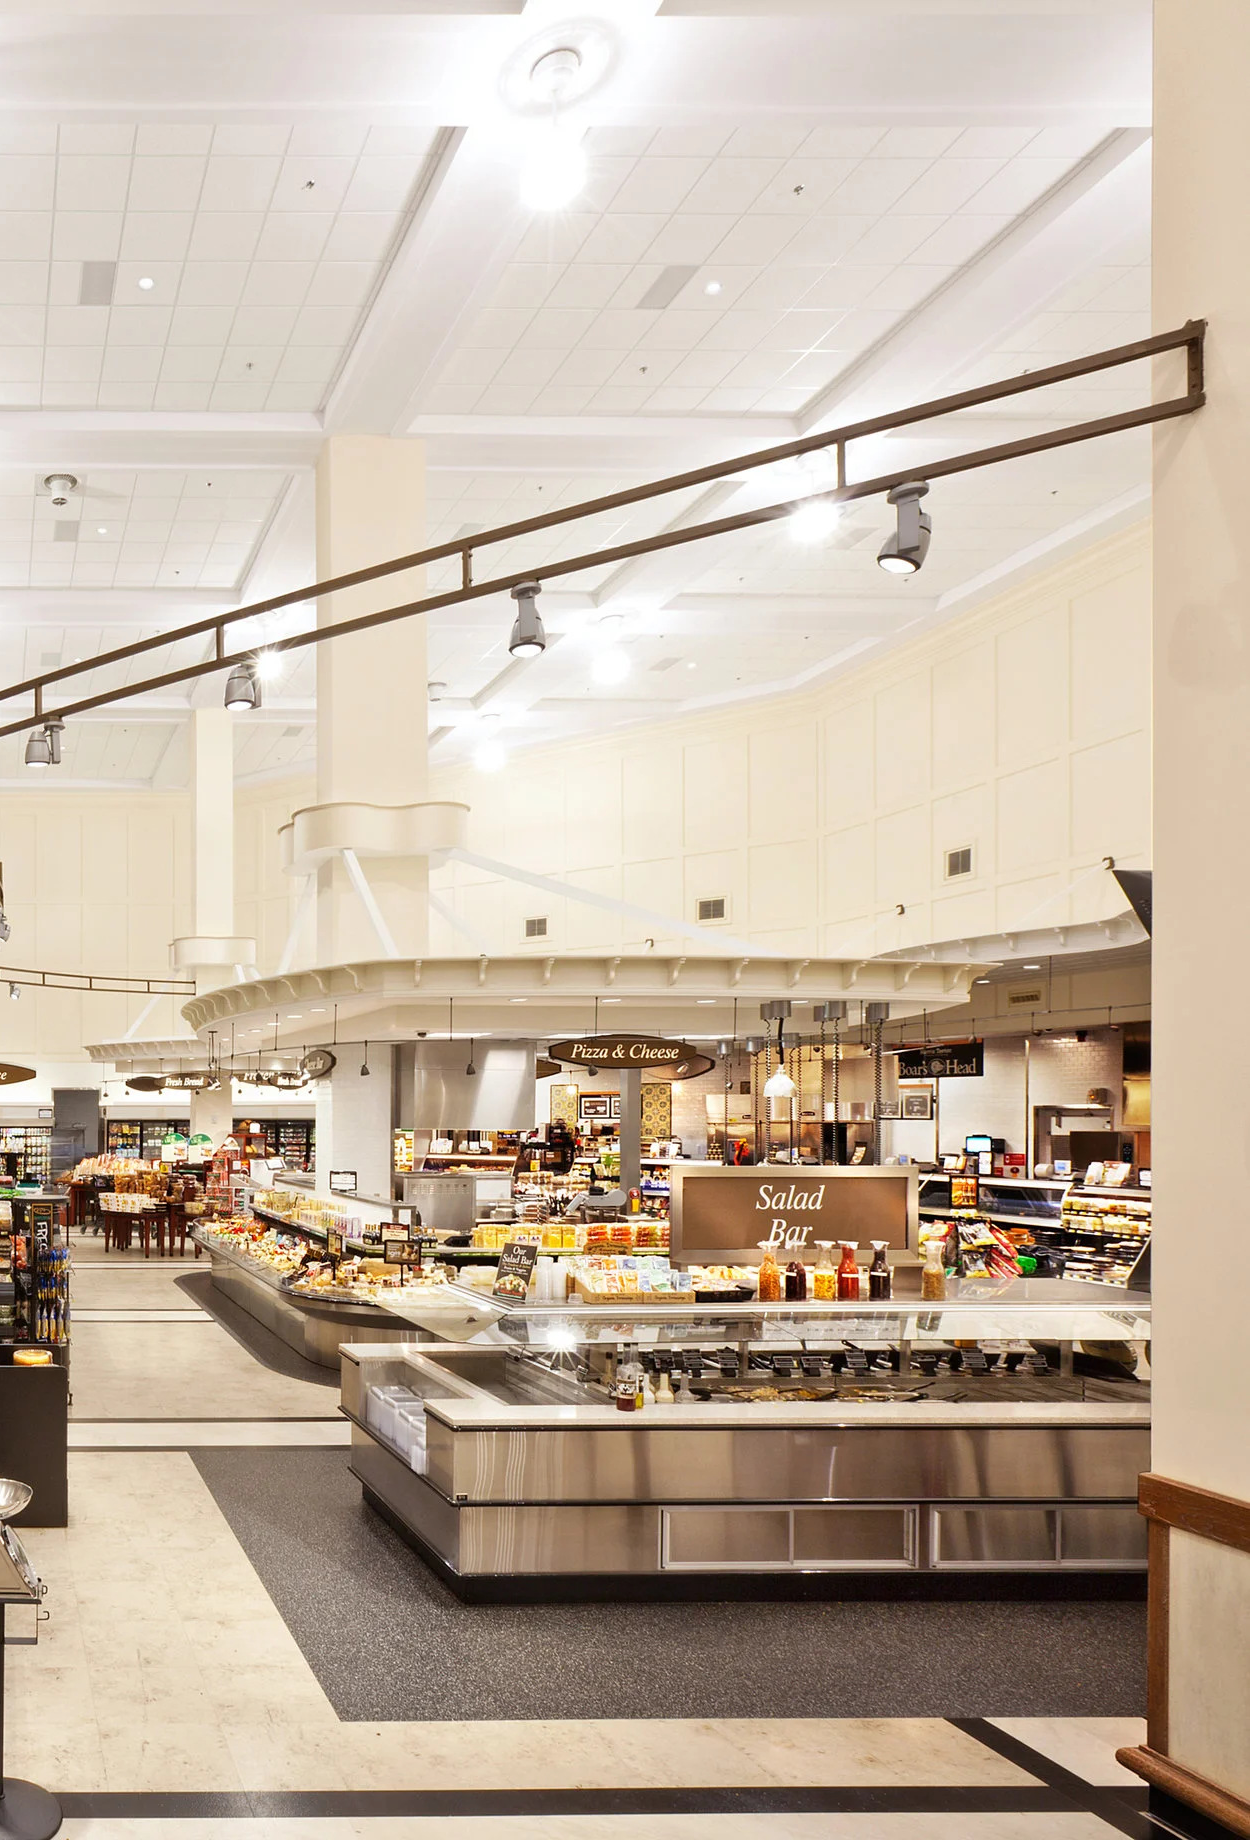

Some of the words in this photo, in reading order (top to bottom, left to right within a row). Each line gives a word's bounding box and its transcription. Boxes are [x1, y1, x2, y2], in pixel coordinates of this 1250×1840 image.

[571, 1044, 608, 1059] Pizza
[611, 1044, 626, 1059] &
[629, 1044, 679, 1059] Cheese
[946, 1058, 977, 1075] Head
[165, 1077, 183, 1087] Fresh
[184, 1077, 204, 1086] Bread
[755, 1184, 826, 1210] Salad
[768, 1218, 813, 1243] Bar
[512, 1246, 527, 1255] Our
[502, 1253, 520, 1264] Salad
[521, 1256, 533, 1265] Bar
